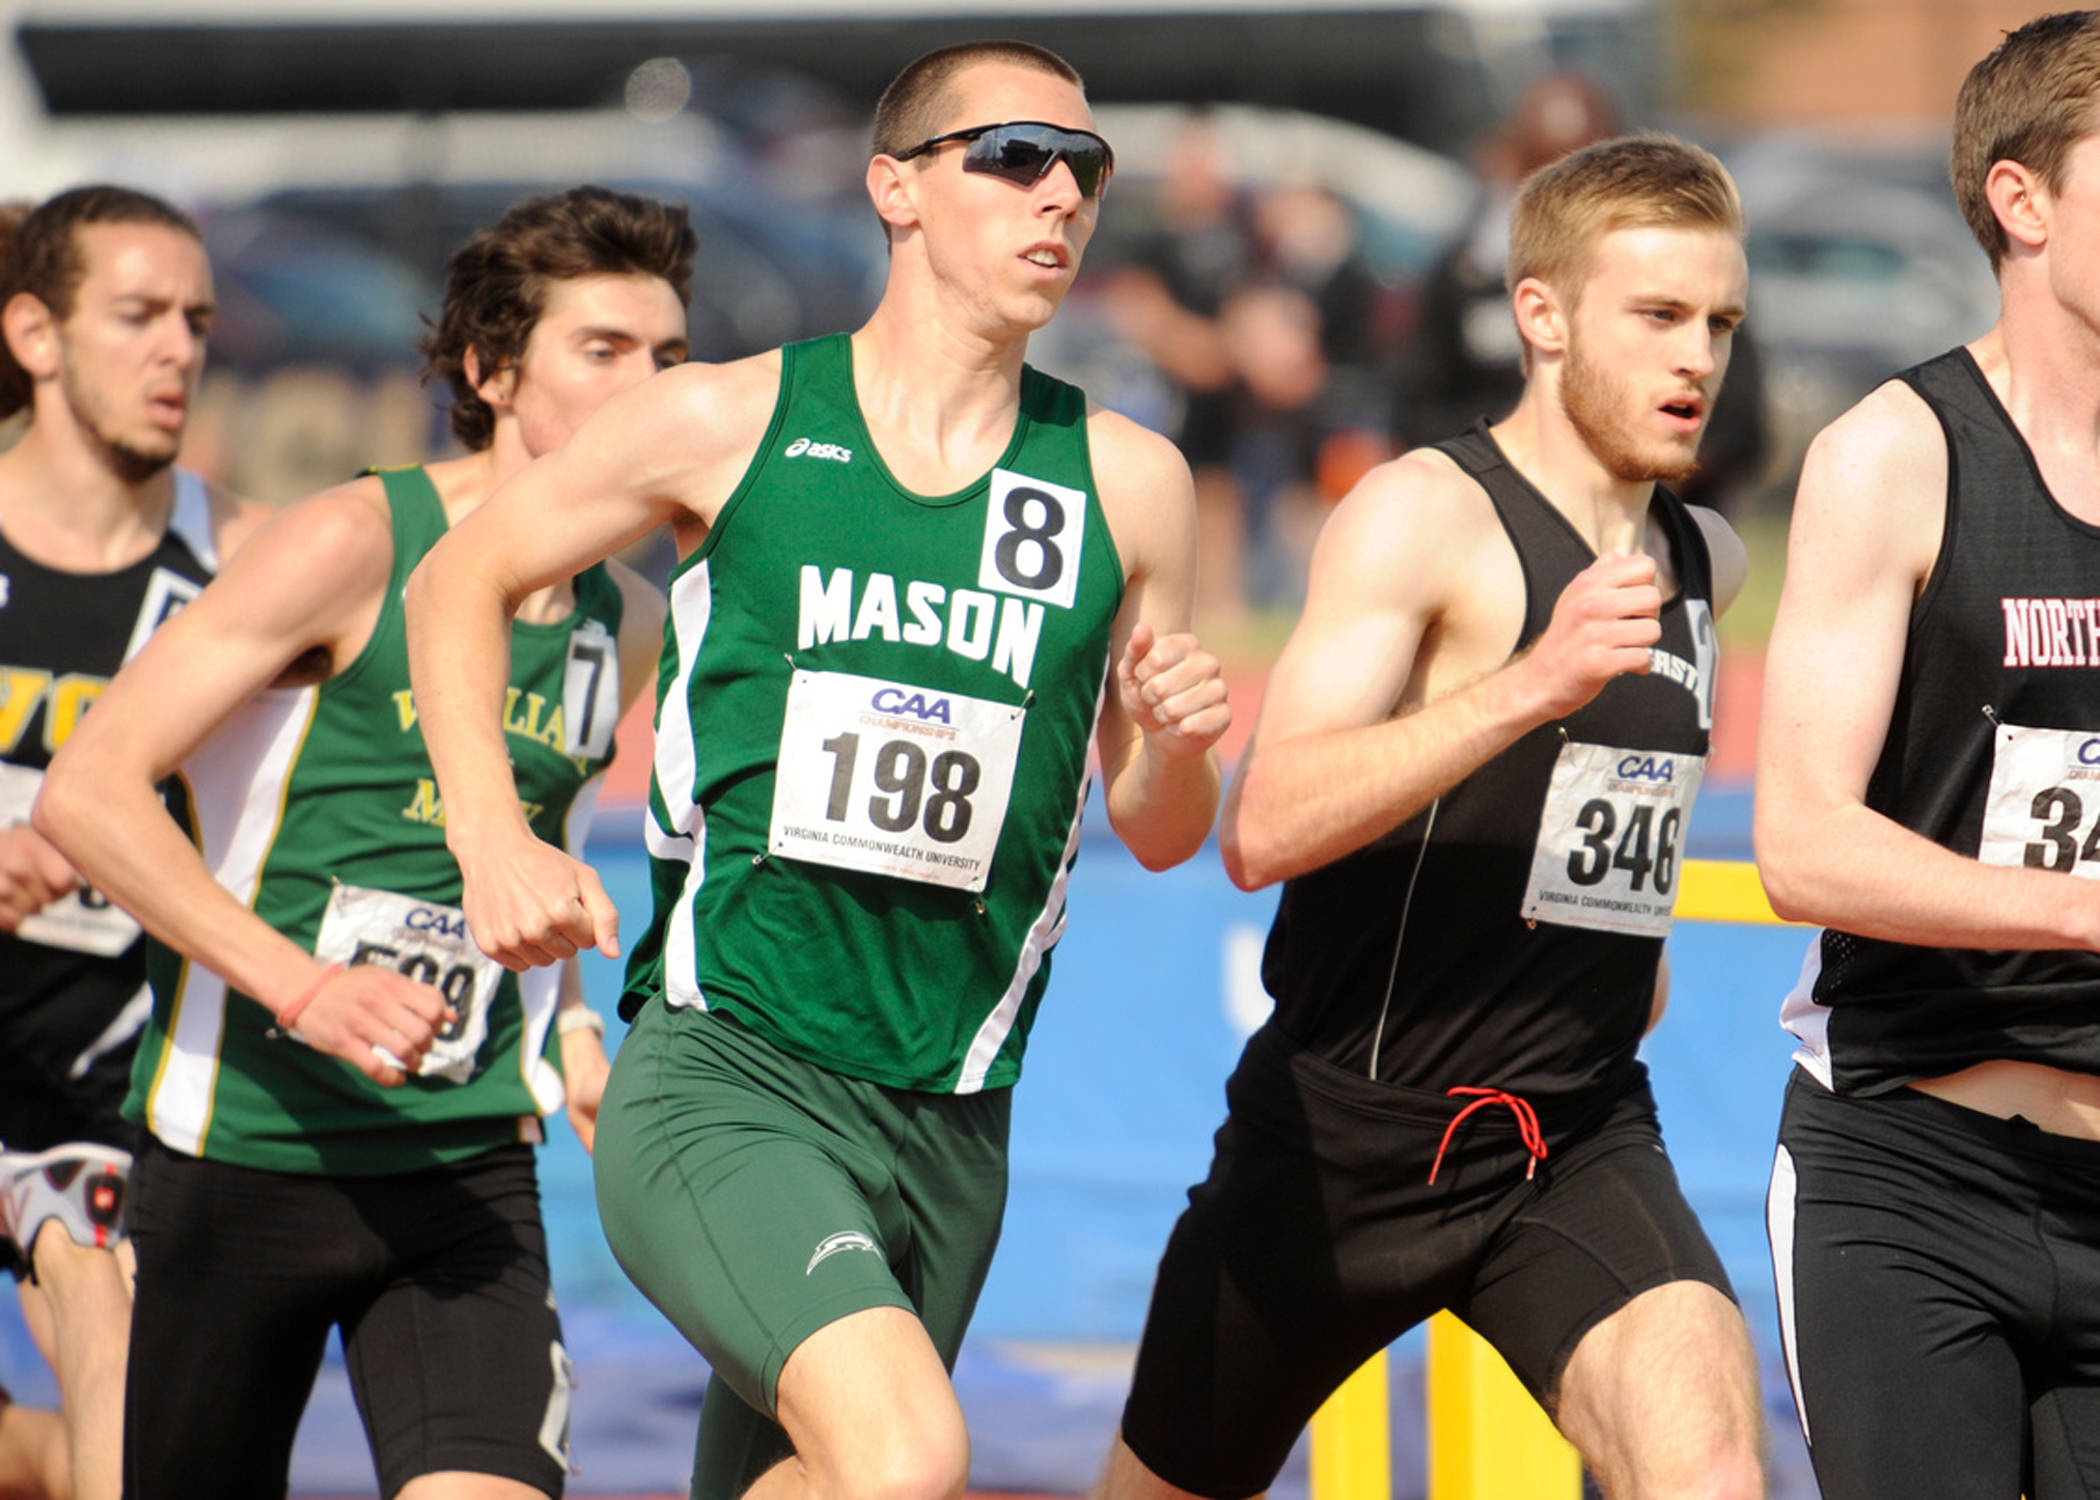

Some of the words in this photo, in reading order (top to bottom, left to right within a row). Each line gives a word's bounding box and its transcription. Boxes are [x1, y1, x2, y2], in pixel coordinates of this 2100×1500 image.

[804, 441, 854, 463] asics
[994, 486, 1066, 590] 8
[798, 565, 1045, 690] MASON
[573, 645, 604, 746] 7
[871, 688, 950, 724] CAA
[822, 732, 981, 843] 198
[1616, 755, 1674, 782] CAA
[783, 825, 829, 843] VIRGINIA
[832, 832, 923, 861] COMMONWEALTH
[925, 850, 981, 872] UNIVERSITY
[1566, 798, 1681, 895] 346
[404, 907, 466, 939] CAA
